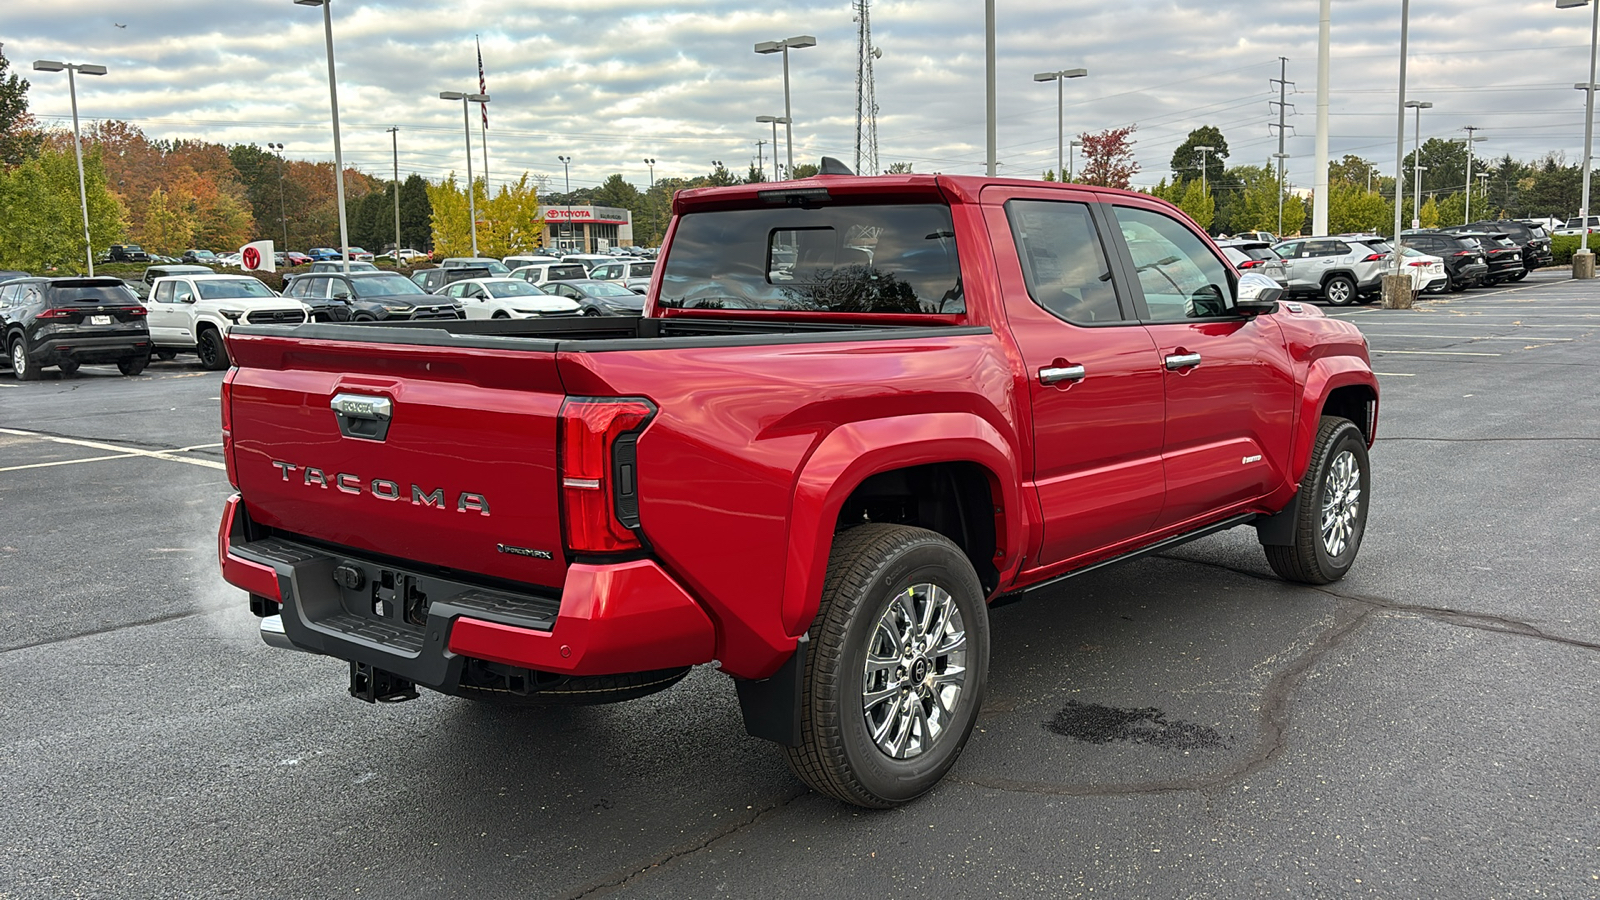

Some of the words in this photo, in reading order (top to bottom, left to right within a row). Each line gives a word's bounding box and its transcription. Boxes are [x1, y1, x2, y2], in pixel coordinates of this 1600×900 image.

[559, 210, 591, 218] TOYOTA
[343, 400, 374, 415] TOYOTA
[272, 460, 491, 517] TACOMA
[961, 575, 984, 625] MICHELIN
[855, 726, 884, 779] MICHELIN
